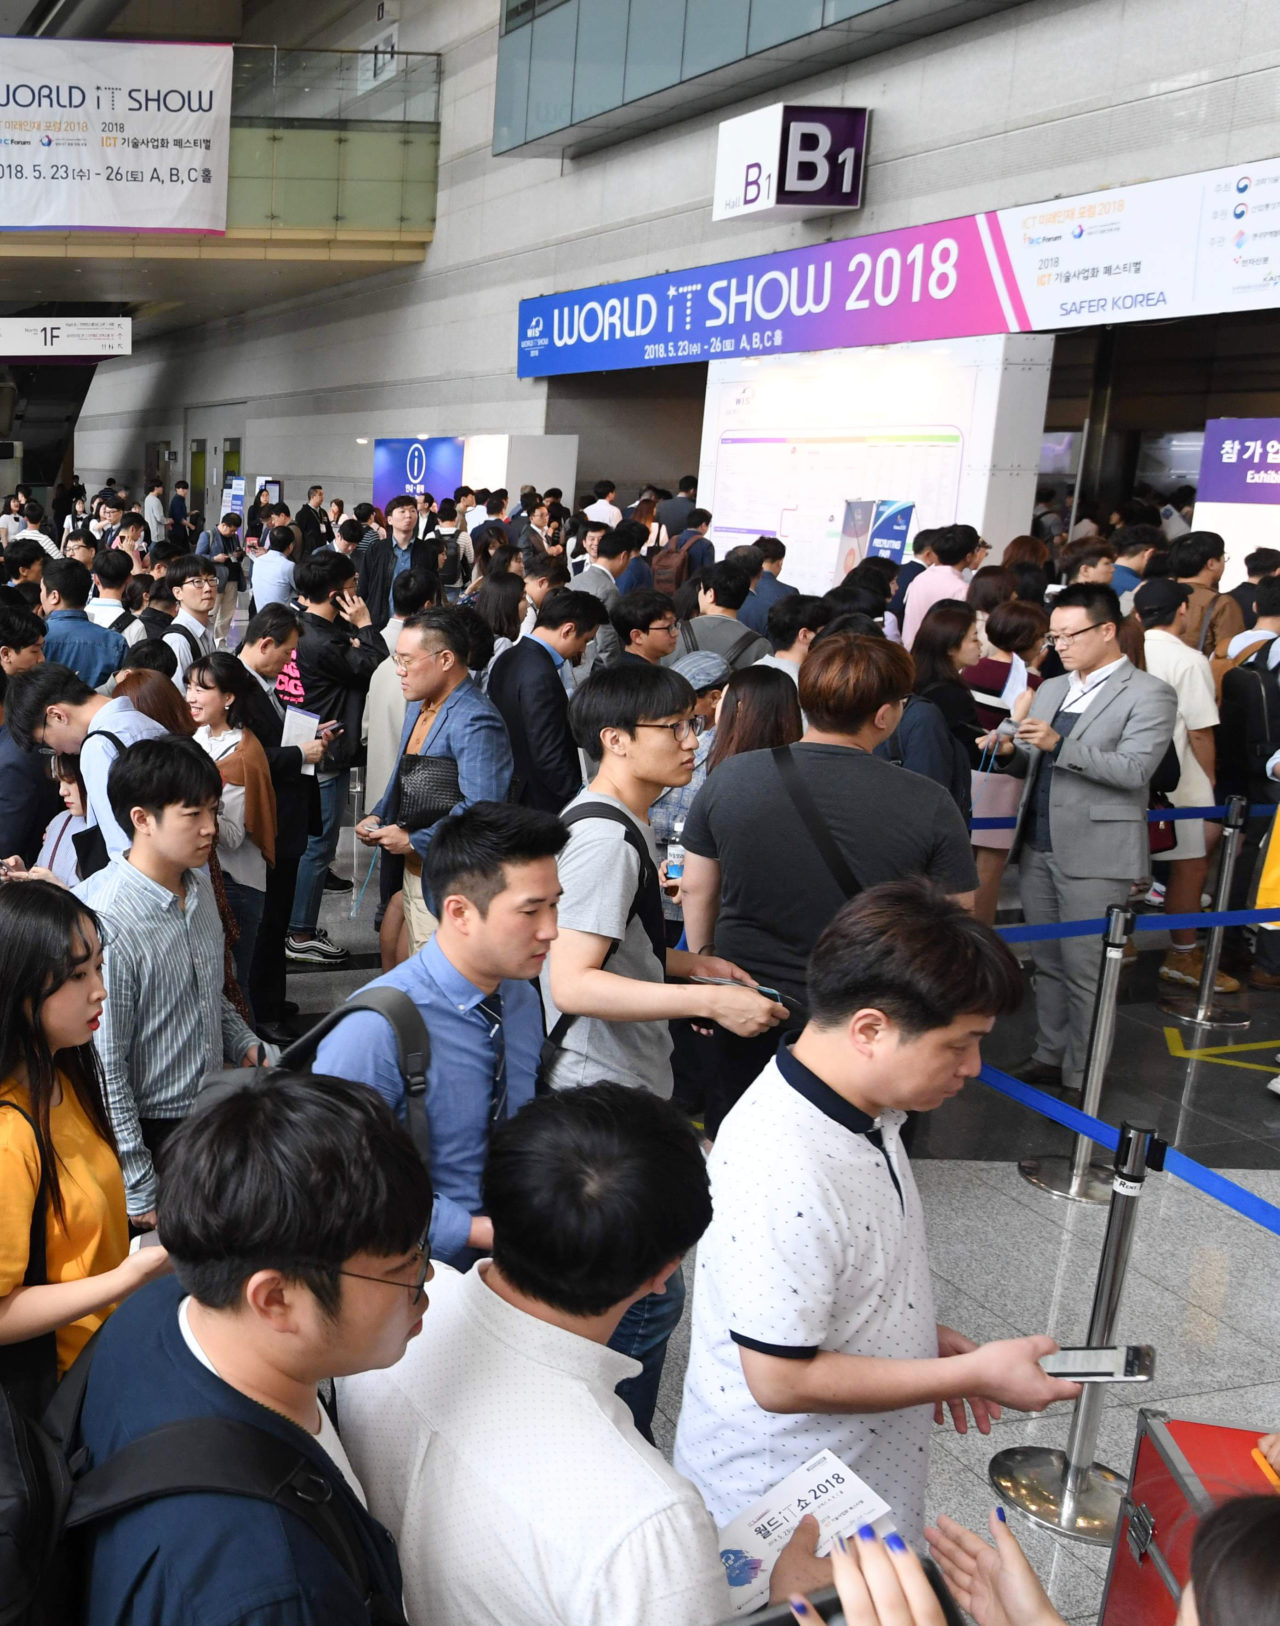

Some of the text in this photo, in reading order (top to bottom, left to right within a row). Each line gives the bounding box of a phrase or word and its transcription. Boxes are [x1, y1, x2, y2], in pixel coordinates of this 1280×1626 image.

[128, 89, 214, 113] SHOW
[64, 121, 88, 132] 2018
[101, 122, 125, 133] 2018
[101, 136, 118, 147] ICT
[121, 137, 169, 149] 기술사업화
[173, 138, 211, 150] 페스티벌
[785, 121, 856, 193] B1
[33, 164, 46, 180] 5.
[150, 167, 164, 184] A,
[169, 167, 184, 184] B,
[743, 162, 771, 205] B1
[1038, 257, 1060, 270] 2018
[1037, 273, 1052, 286] ICT
[553, 293, 657, 348] WORLD
[705, 260, 832, 327] SHOW
[845, 237, 960, 311] 2018
[1060, 291, 1167, 317] SAFER KOREA
[40, 326, 61, 346] 1F
[644, 344, 666, 359] 2018.
[668, 343, 676, 357] 5.
[754, 1516, 784, 1540] 월드
[796, 1498, 811, 1512] 쇼
[808, 1473, 846, 1500] 2018
